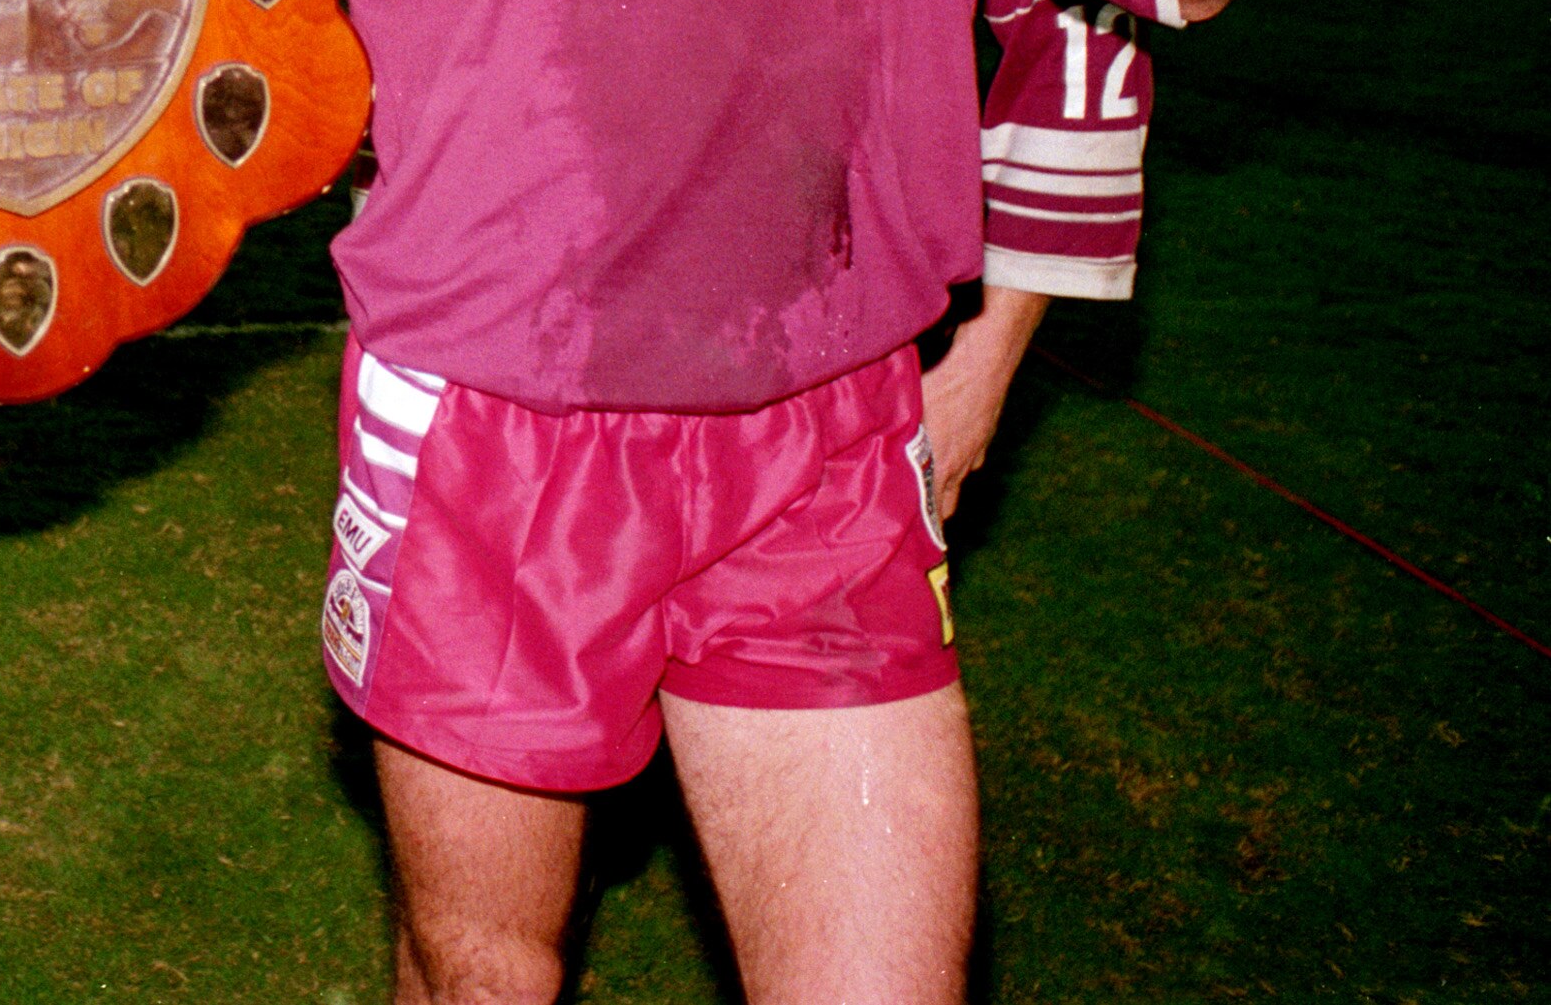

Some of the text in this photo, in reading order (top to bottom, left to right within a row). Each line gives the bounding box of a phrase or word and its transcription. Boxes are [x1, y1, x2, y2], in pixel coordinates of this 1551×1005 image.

[1057, 4, 1139, 120] 12
[81, 68, 146, 108] OF
[337, 508, 373, 553] EMU
